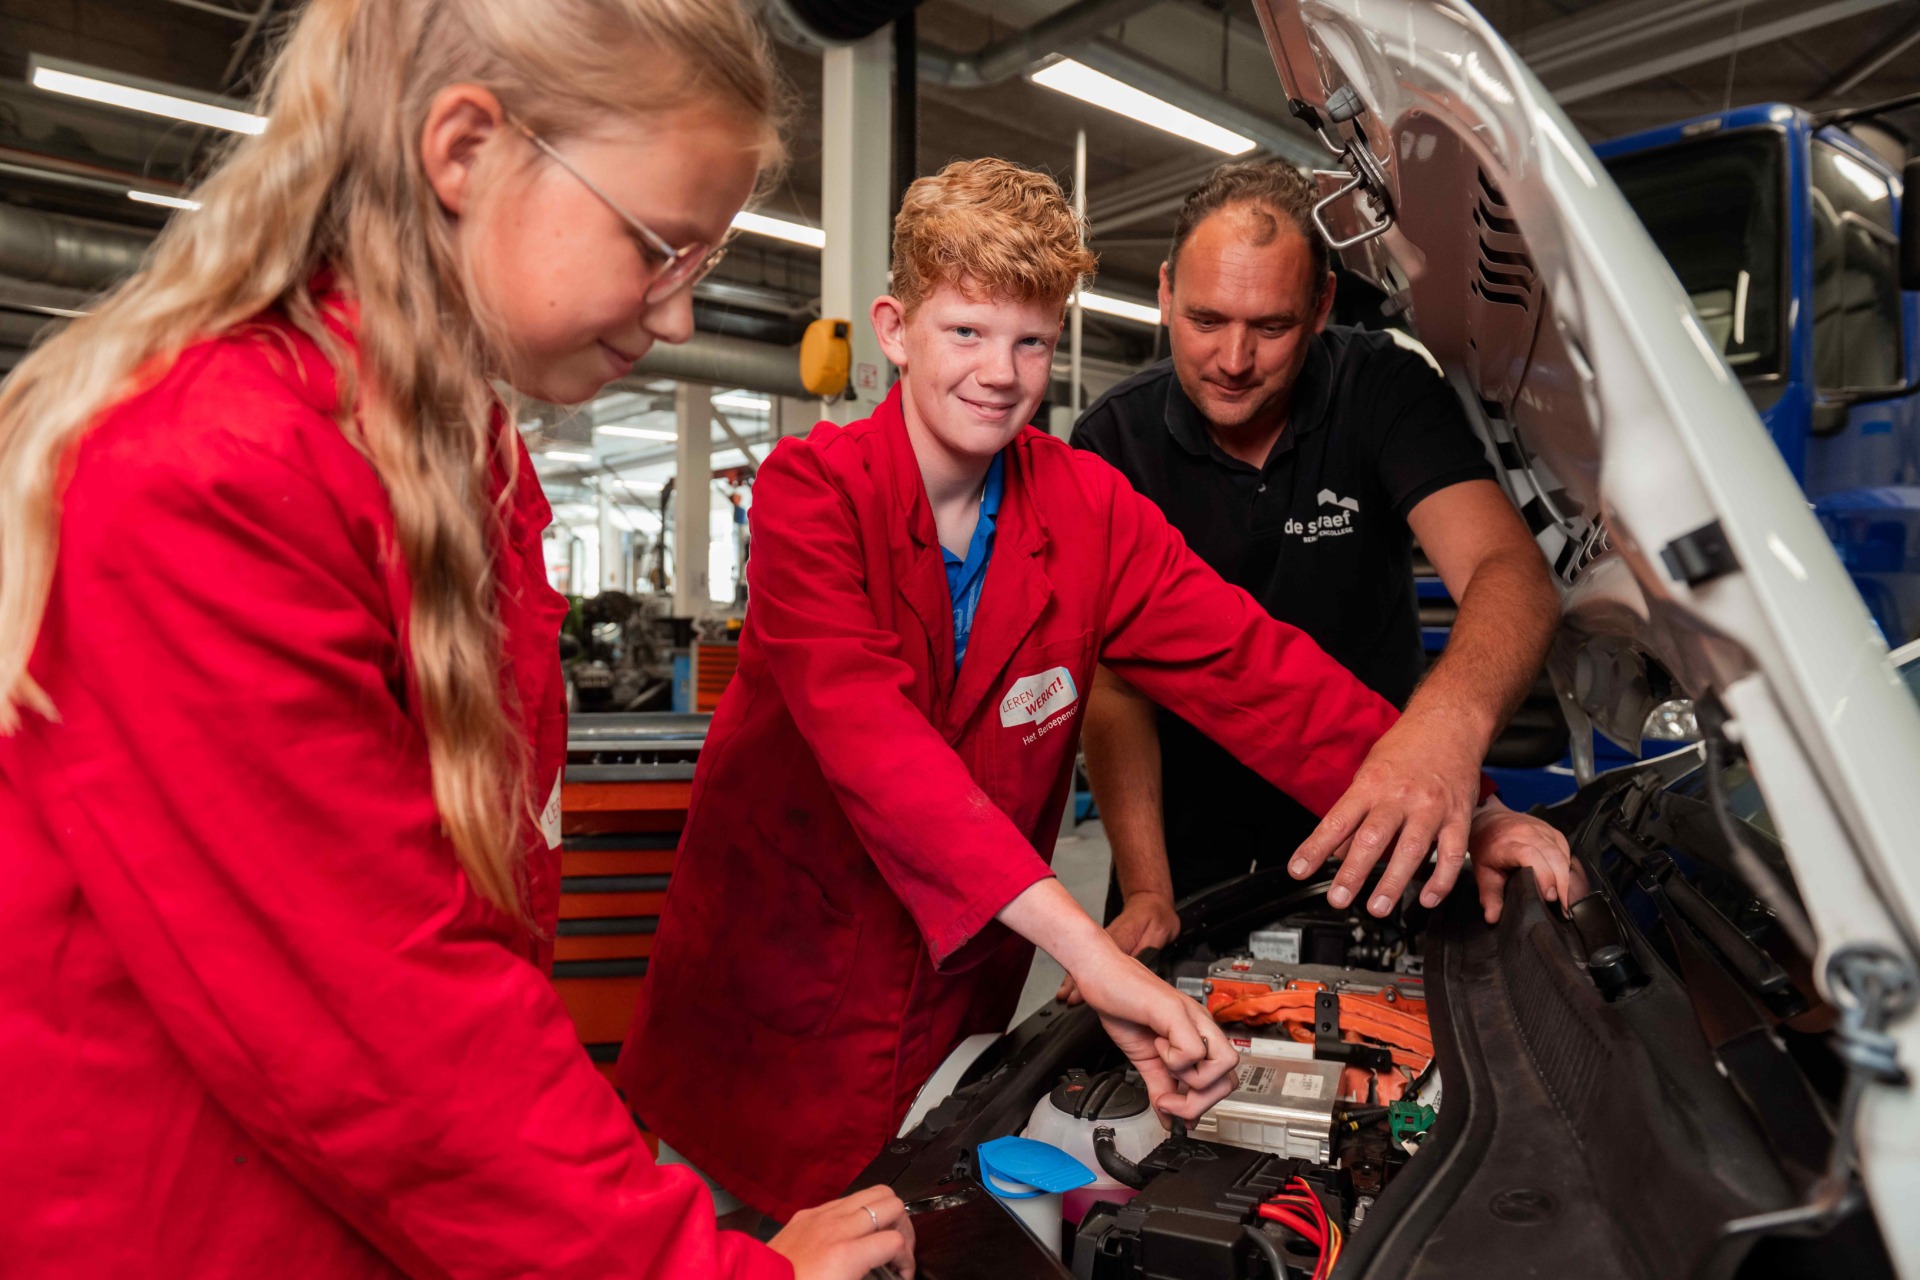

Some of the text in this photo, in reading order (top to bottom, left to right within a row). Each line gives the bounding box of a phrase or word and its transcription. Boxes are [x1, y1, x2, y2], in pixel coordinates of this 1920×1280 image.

[1284, 518, 1303, 535] de
[1002, 689, 1034, 713] LEREN
[1025, 676, 1064, 716] WERKT!
[1022, 701, 1079, 745] Het Beroepenco
